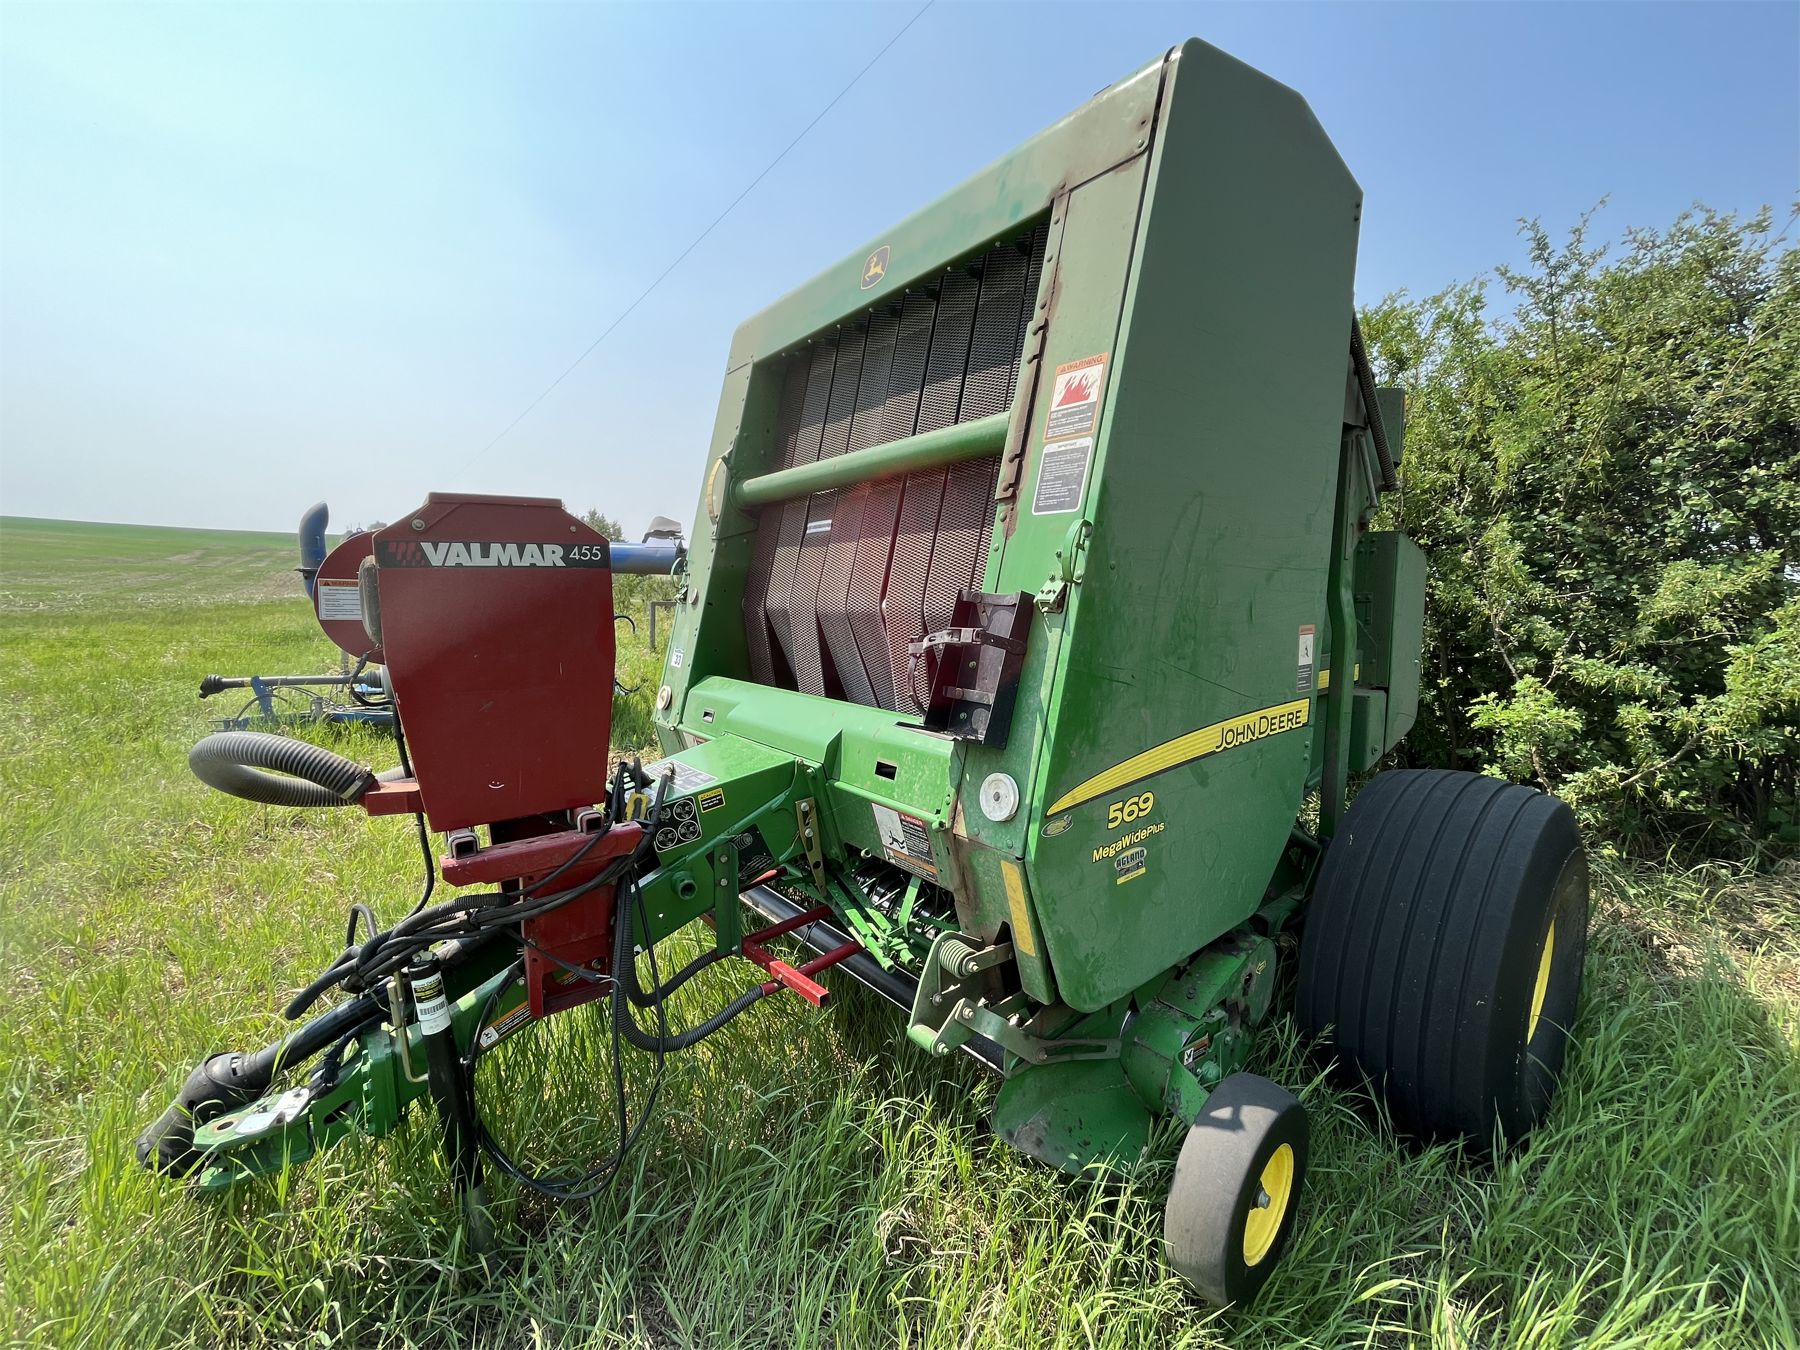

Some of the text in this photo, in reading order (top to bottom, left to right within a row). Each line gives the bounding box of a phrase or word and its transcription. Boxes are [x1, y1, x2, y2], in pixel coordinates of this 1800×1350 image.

[1066, 355, 1103, 371] WARNING
[420, 542, 602, 567] VALMAR 455
[1215, 709, 1302, 750] JOHN DEERE
[1107, 791, 1154, 830] 569
[1092, 822, 1165, 863] MegaWidePlus
